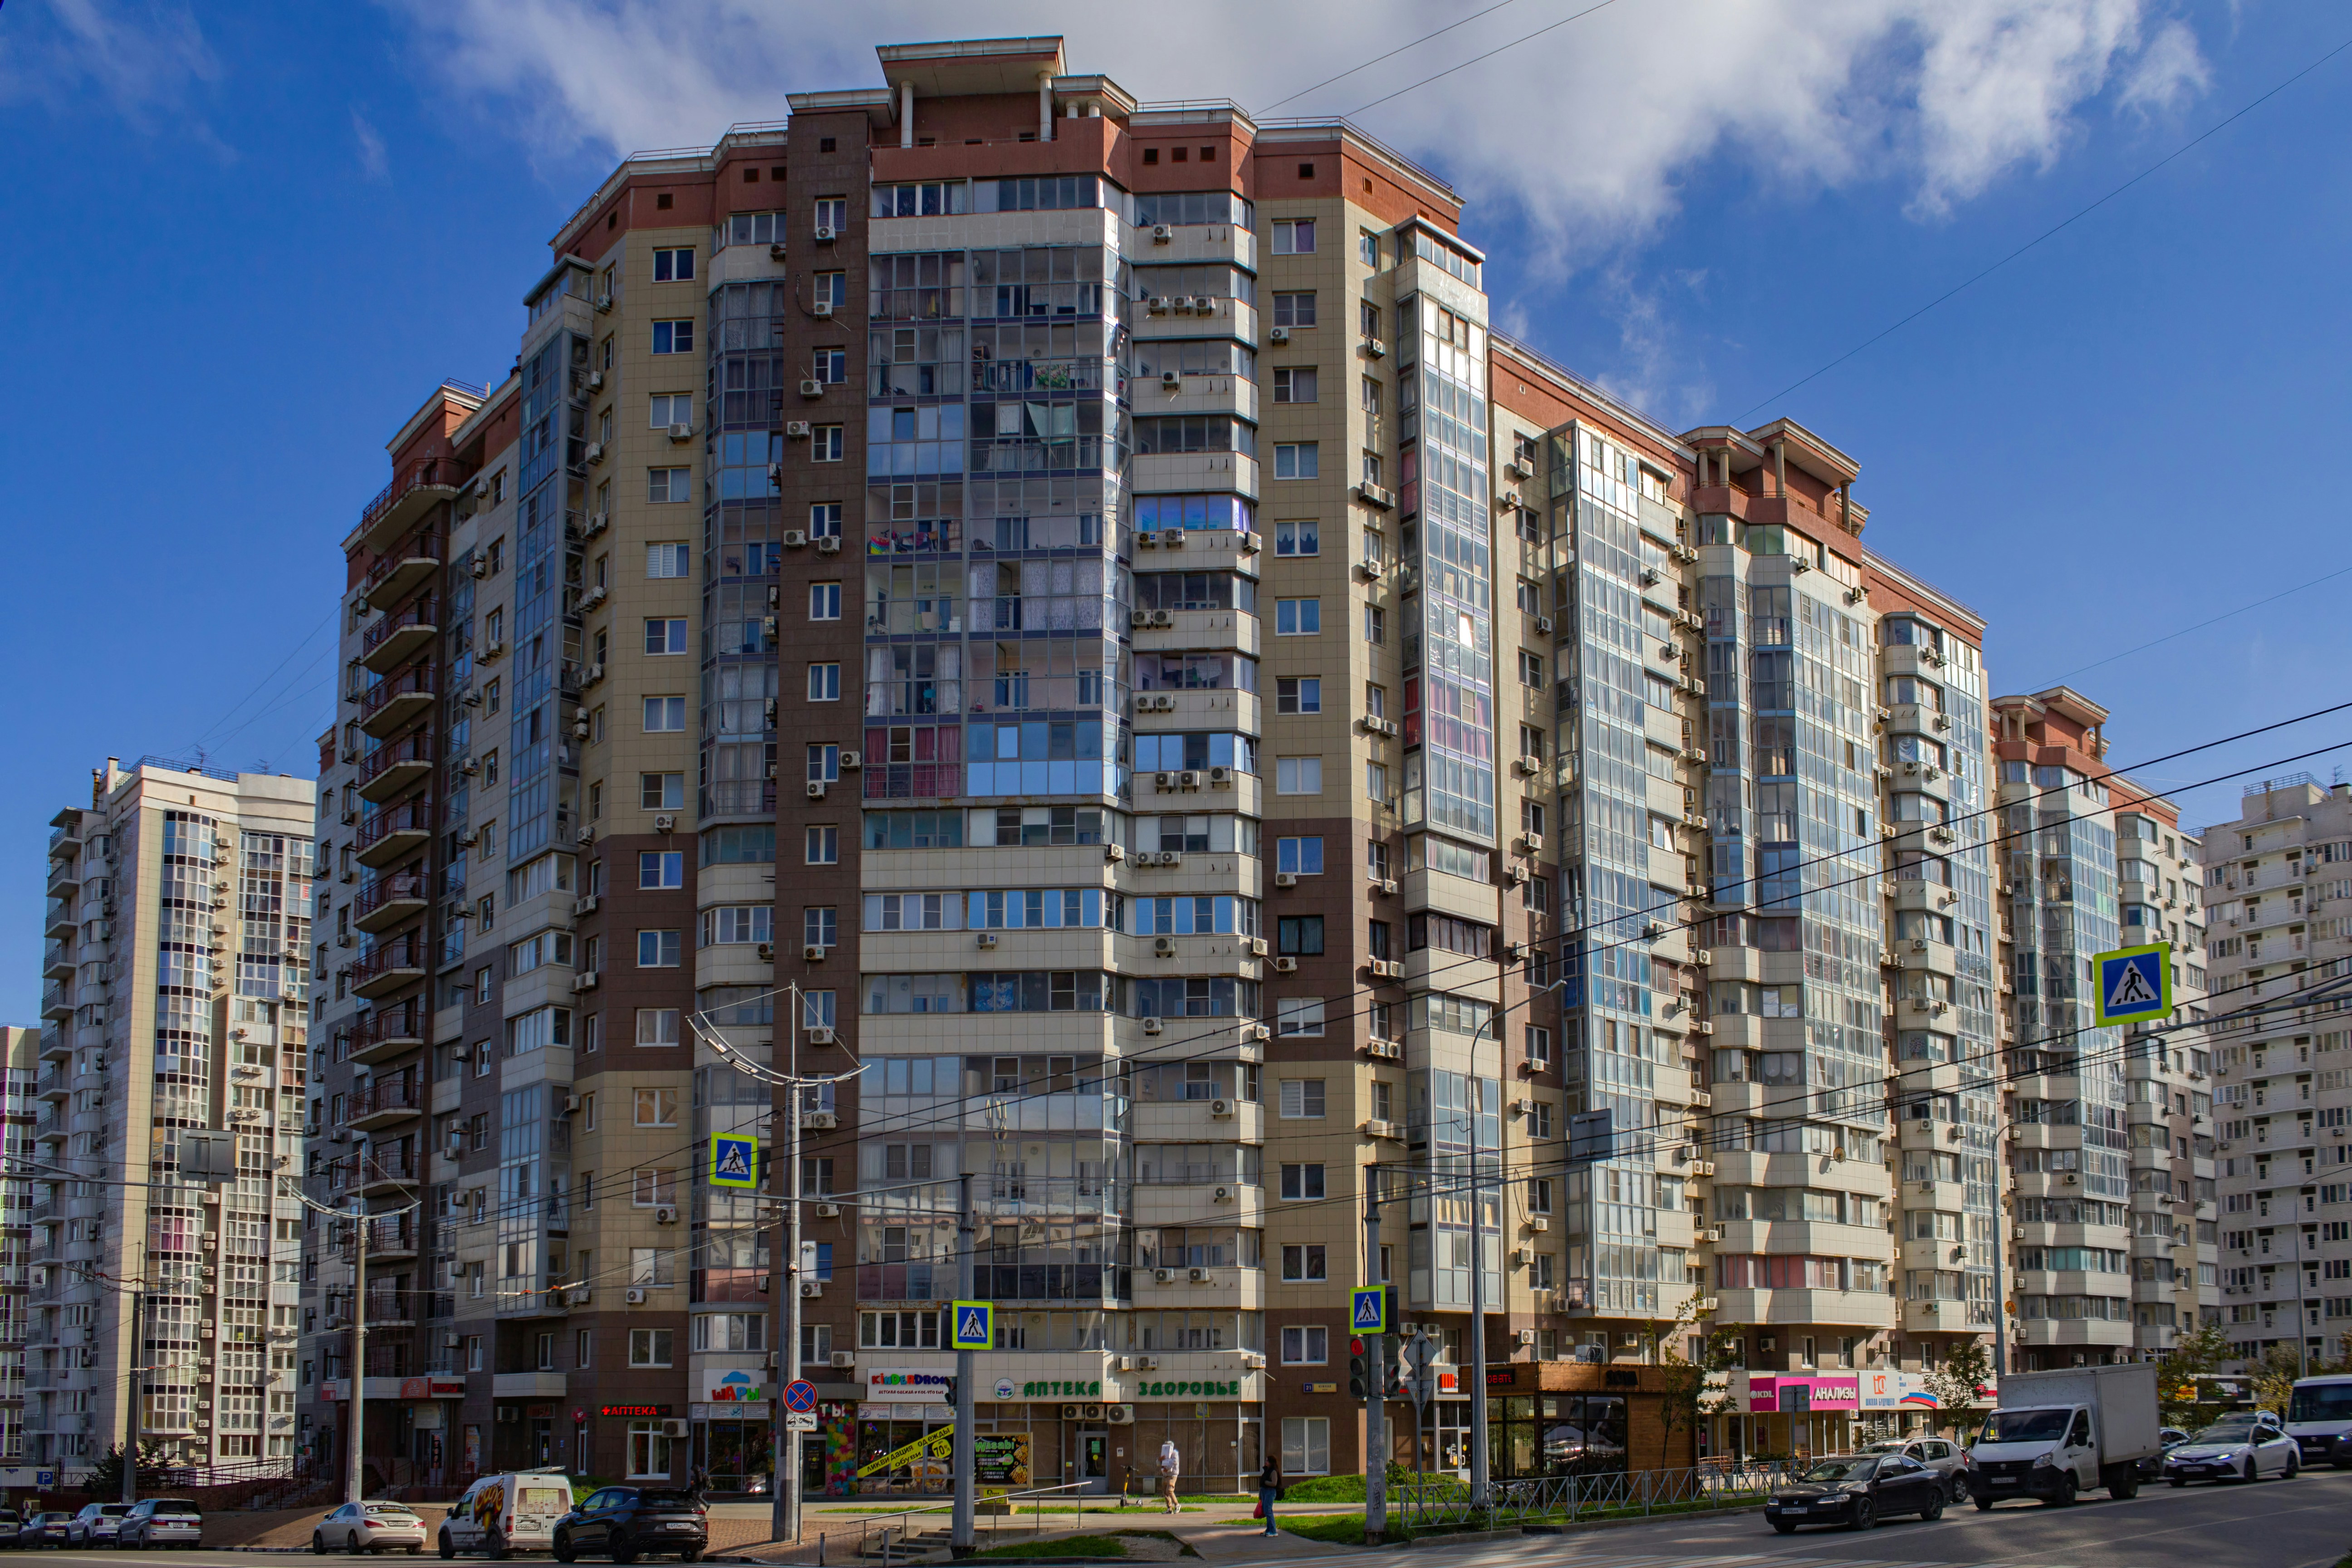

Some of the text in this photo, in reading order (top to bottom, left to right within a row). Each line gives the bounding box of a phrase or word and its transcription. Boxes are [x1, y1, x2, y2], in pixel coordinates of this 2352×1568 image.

[712, 1386, 760, 1401] ШАРЫ
[1024, 1381, 1239, 1397] АПТЕКА ЗДОРОВЬЕ
[1815, 1387, 1856, 1400] АНАЛИЗЫ
[1878, 1398, 1895, 1406] БУДУЩЕГО
[612, 1406, 657, 1416] АПТЕКА
[975, 1440, 1014, 1452] Wasabi
[42, 1473, 50, 1484] P
